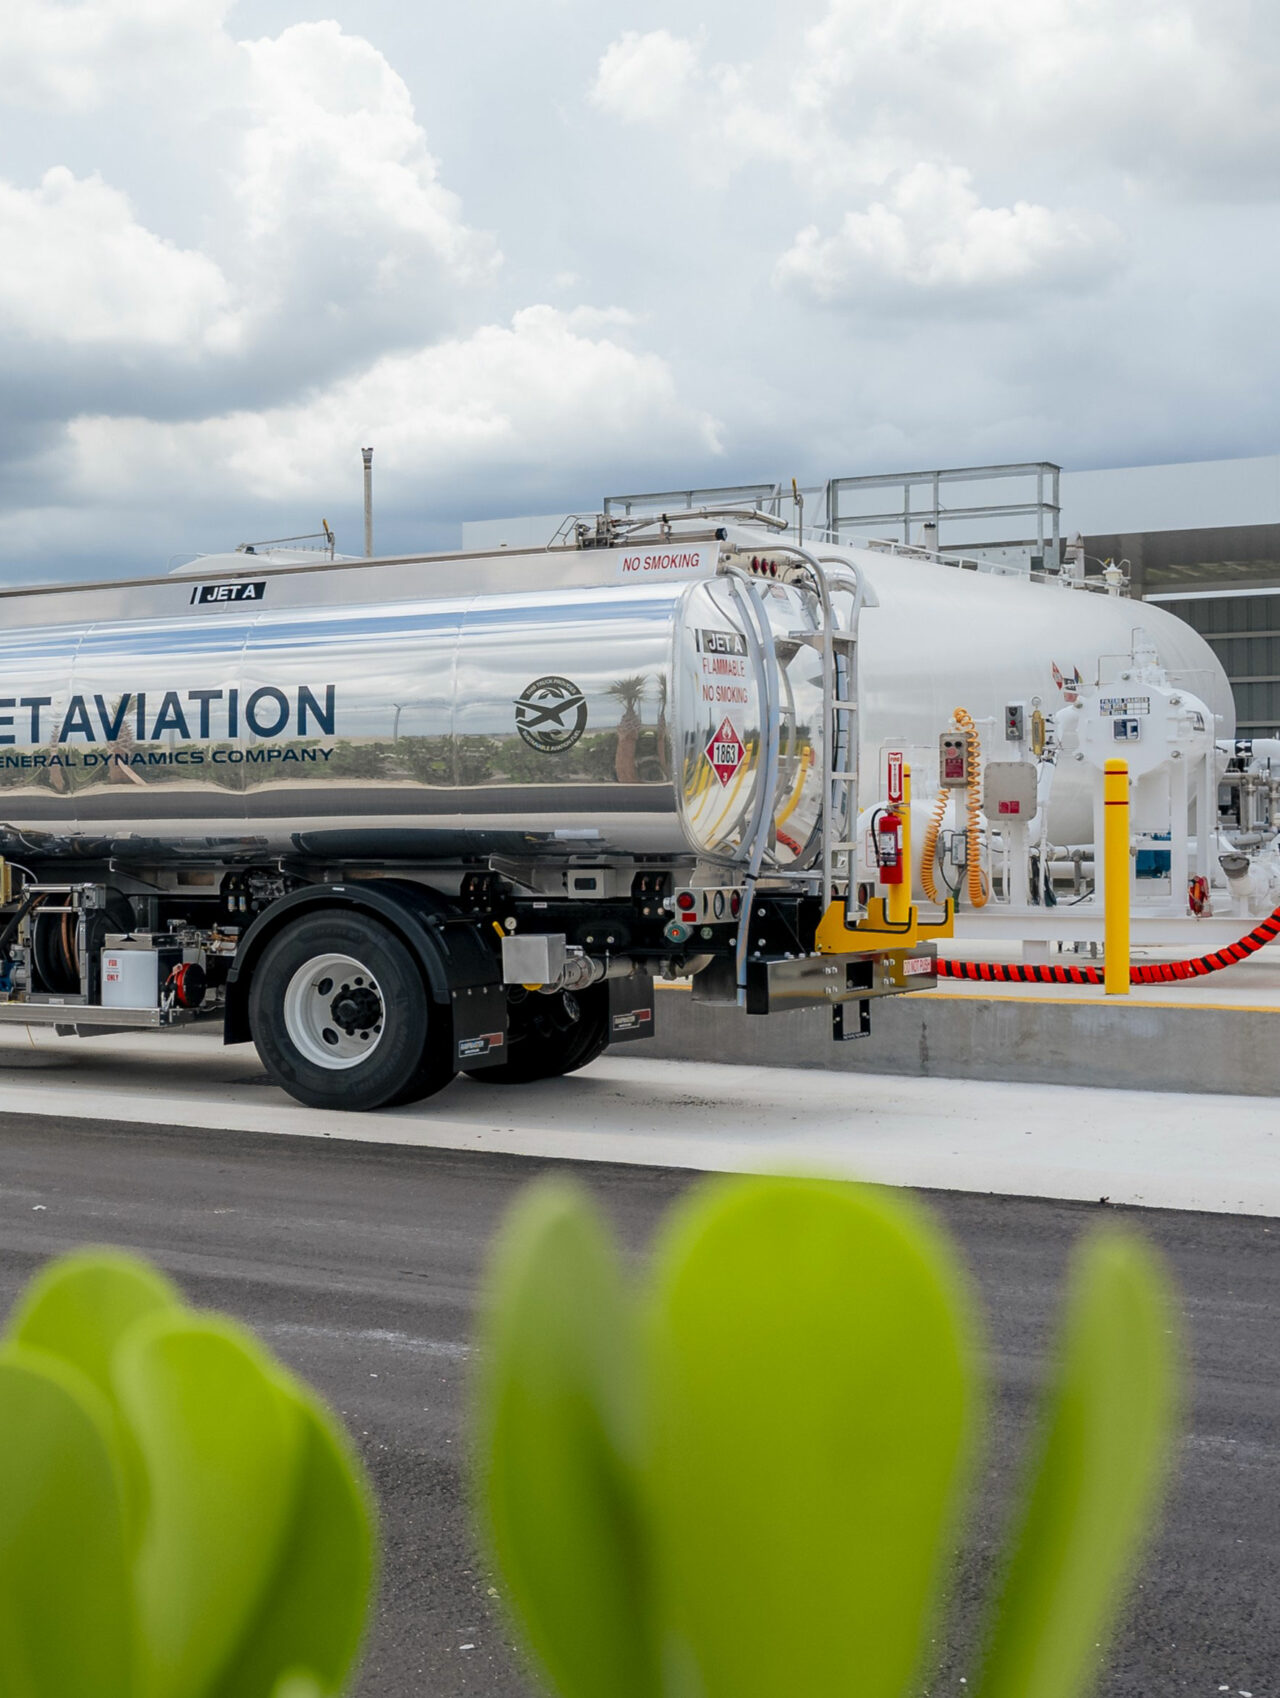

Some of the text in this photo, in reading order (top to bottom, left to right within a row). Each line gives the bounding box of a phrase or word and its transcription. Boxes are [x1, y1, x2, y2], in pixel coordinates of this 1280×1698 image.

[623, 553, 700, 572] NO SMOKING
[207, 584, 256, 601] JET A
[709, 633, 743, 653] JET A
[702, 657, 745, 677] FLAMMABLE
[702, 684, 748, 703] NO SMOKING
[58, 684, 336, 742] AVIATION
[83, 750, 204, 767] DYNAMICS
[211, 747, 335, 764] COMPANY
[716, 744, 736, 764] 1863
[722, 772, 728, 782] 3
